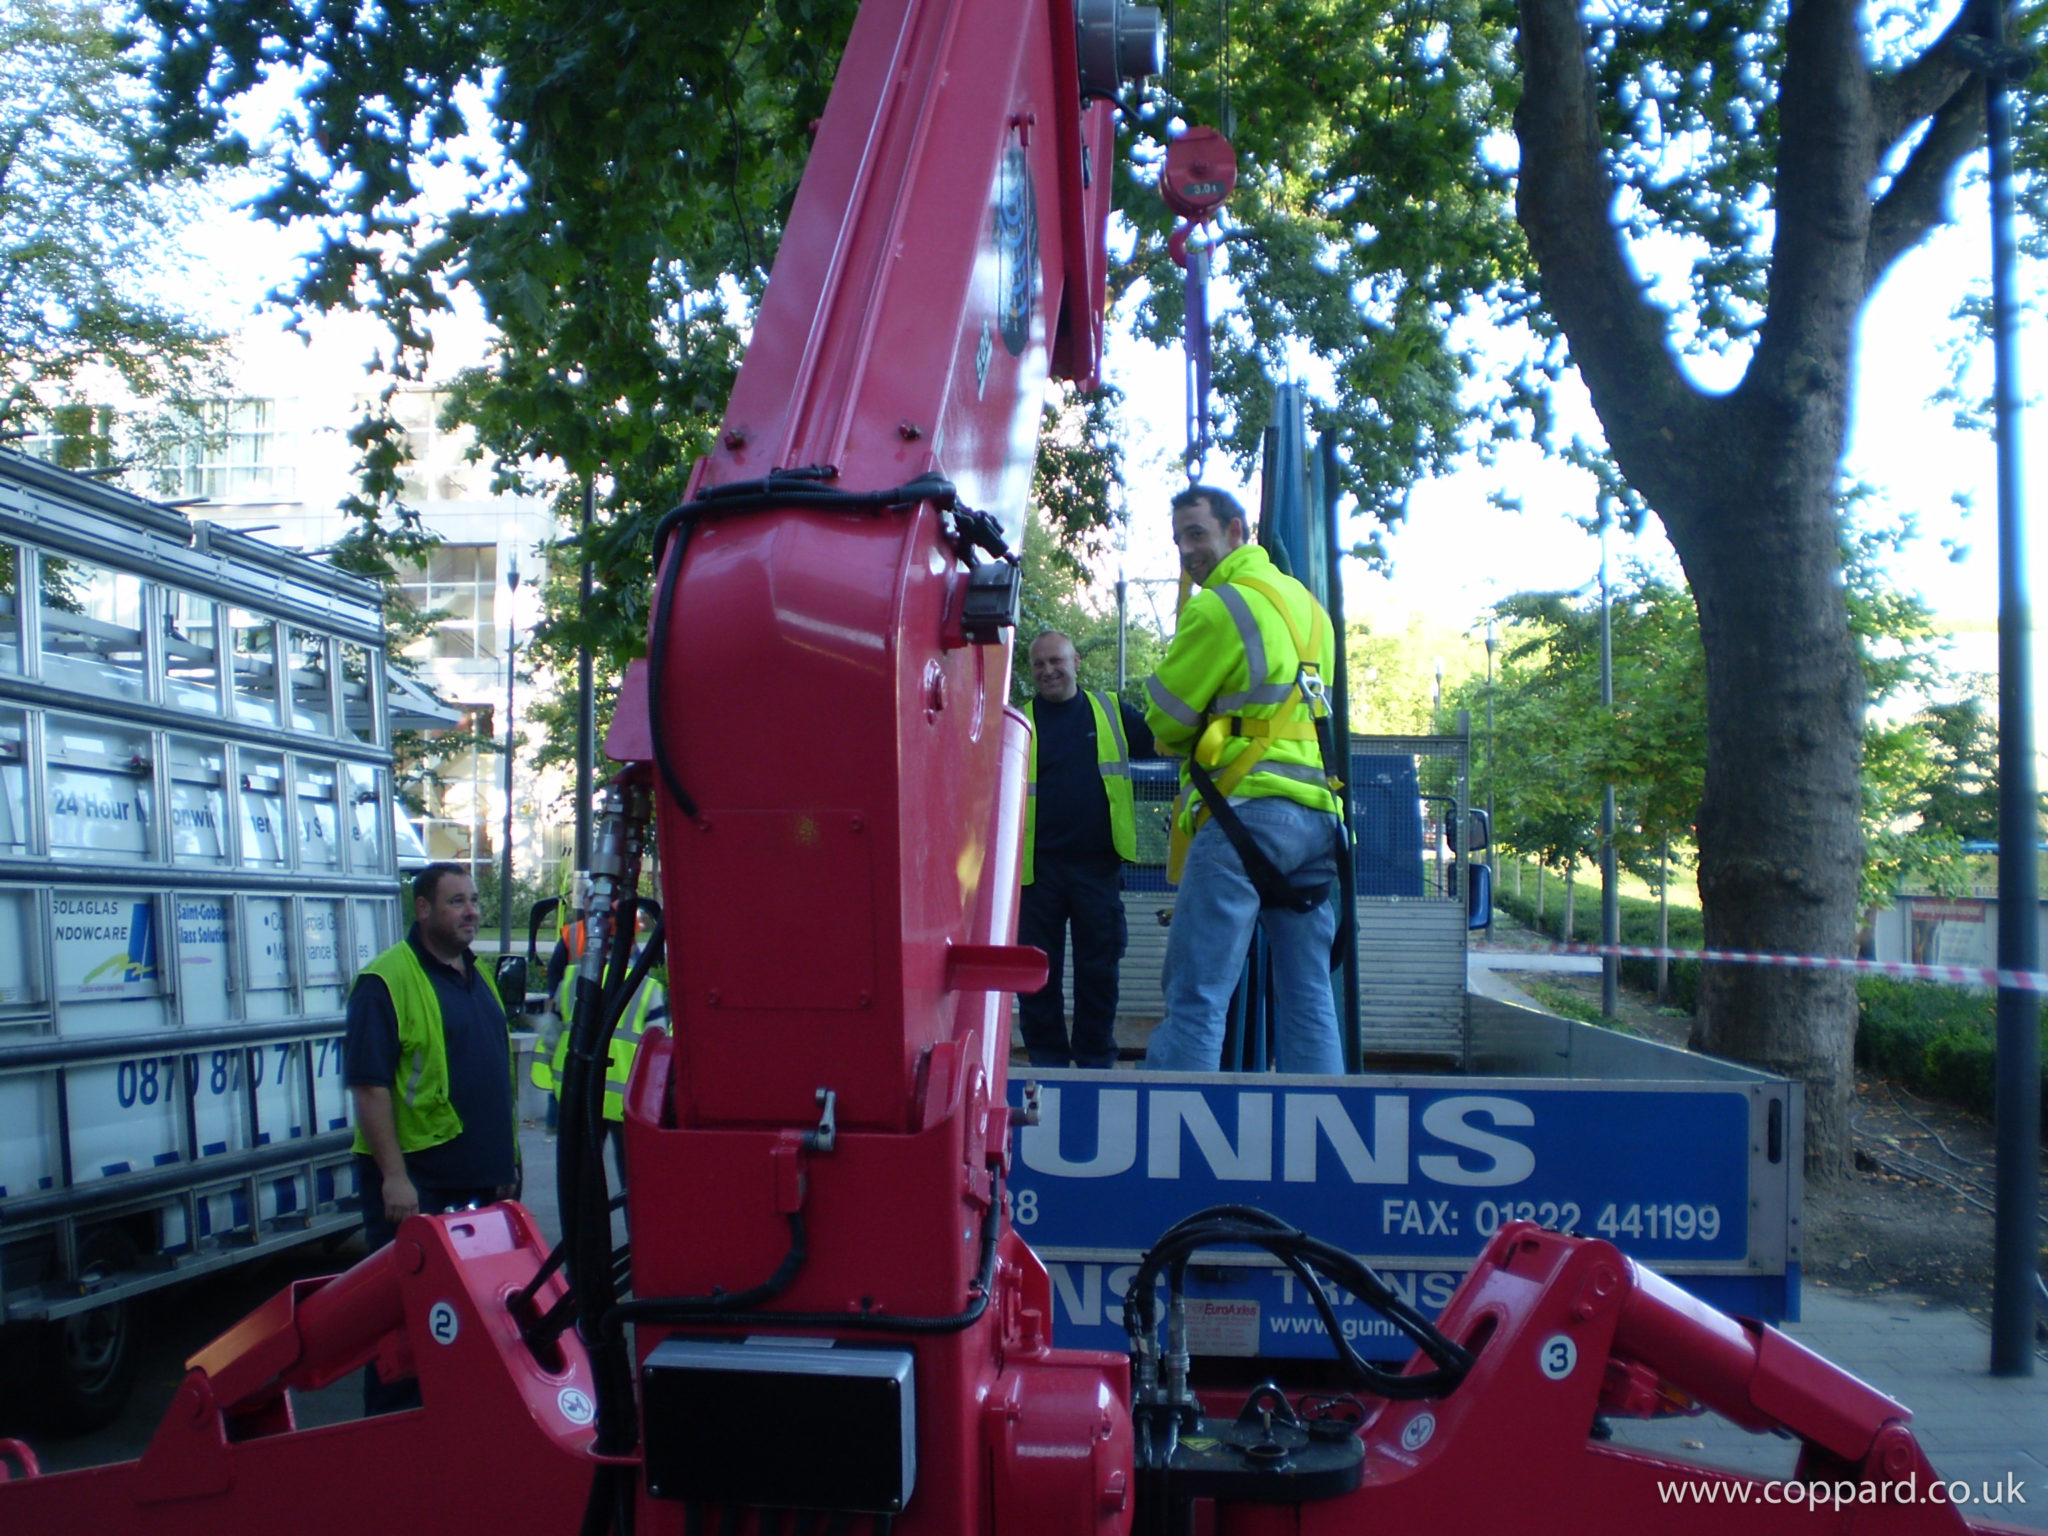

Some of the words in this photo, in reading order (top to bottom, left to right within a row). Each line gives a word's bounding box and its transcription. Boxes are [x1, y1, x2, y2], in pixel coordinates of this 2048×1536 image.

[54, 788, 79, 816] 24
[85, 793, 130, 822] Hour
[1382, 1199, 1460, 1236] FAX:
[1596, 1203, 1721, 1241] 441199
[435, 1308, 451, 1339] 2
[1549, 1342, 1569, 1373] 3
